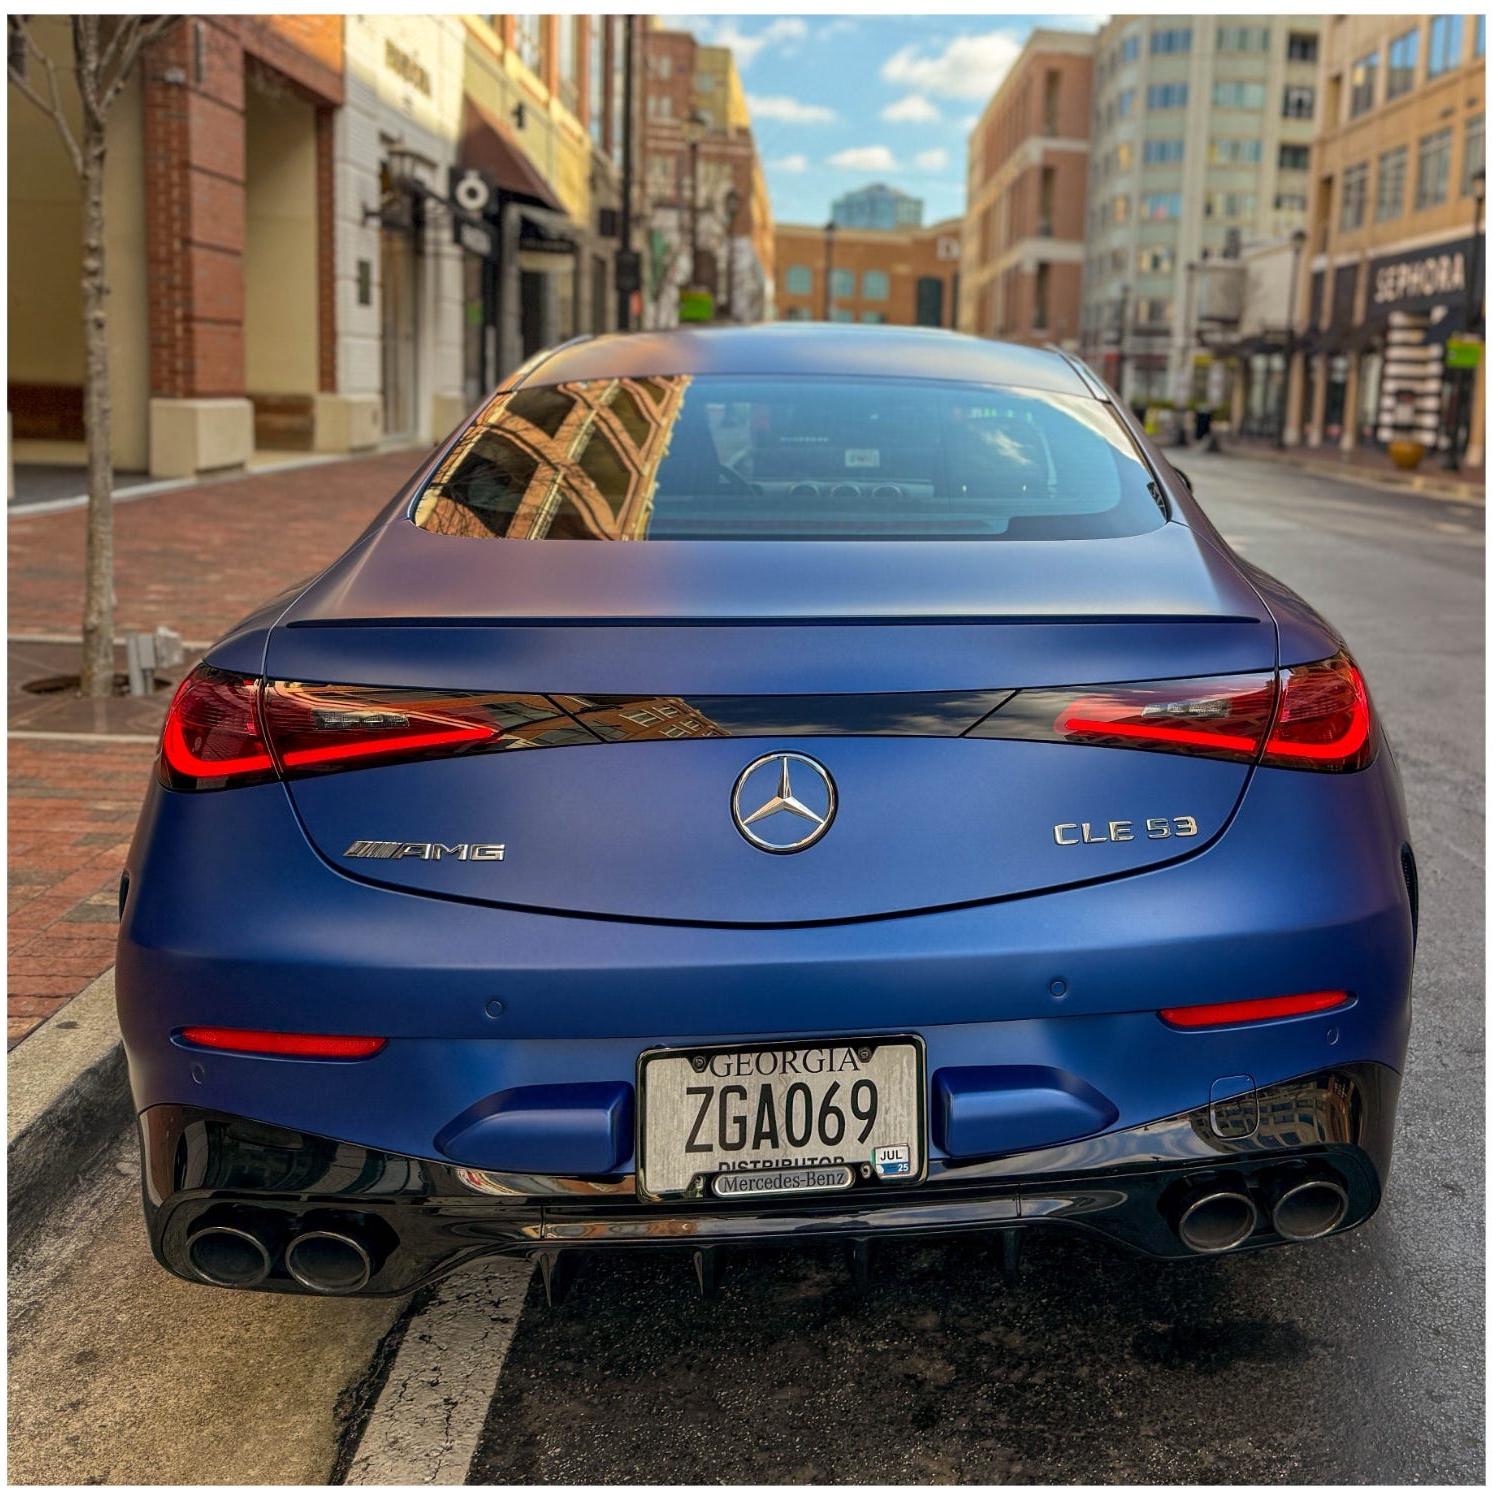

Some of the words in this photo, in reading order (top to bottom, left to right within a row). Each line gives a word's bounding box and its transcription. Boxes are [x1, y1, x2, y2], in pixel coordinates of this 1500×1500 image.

[1375, 251, 1466, 303] SEPHORA
[1054, 820, 1135, 846] CLE
[1146, 815, 1199, 839] 53
[396, 842, 506, 861] AMG
[709, 1046, 861, 1078] GEORGIA
[684, 1078, 879, 1154] ZGA069
[880, 1149, 903, 1161] JUL
[897, 1162, 909, 1172] 25
[722, 1170, 846, 1193] Mercedes-Benz
